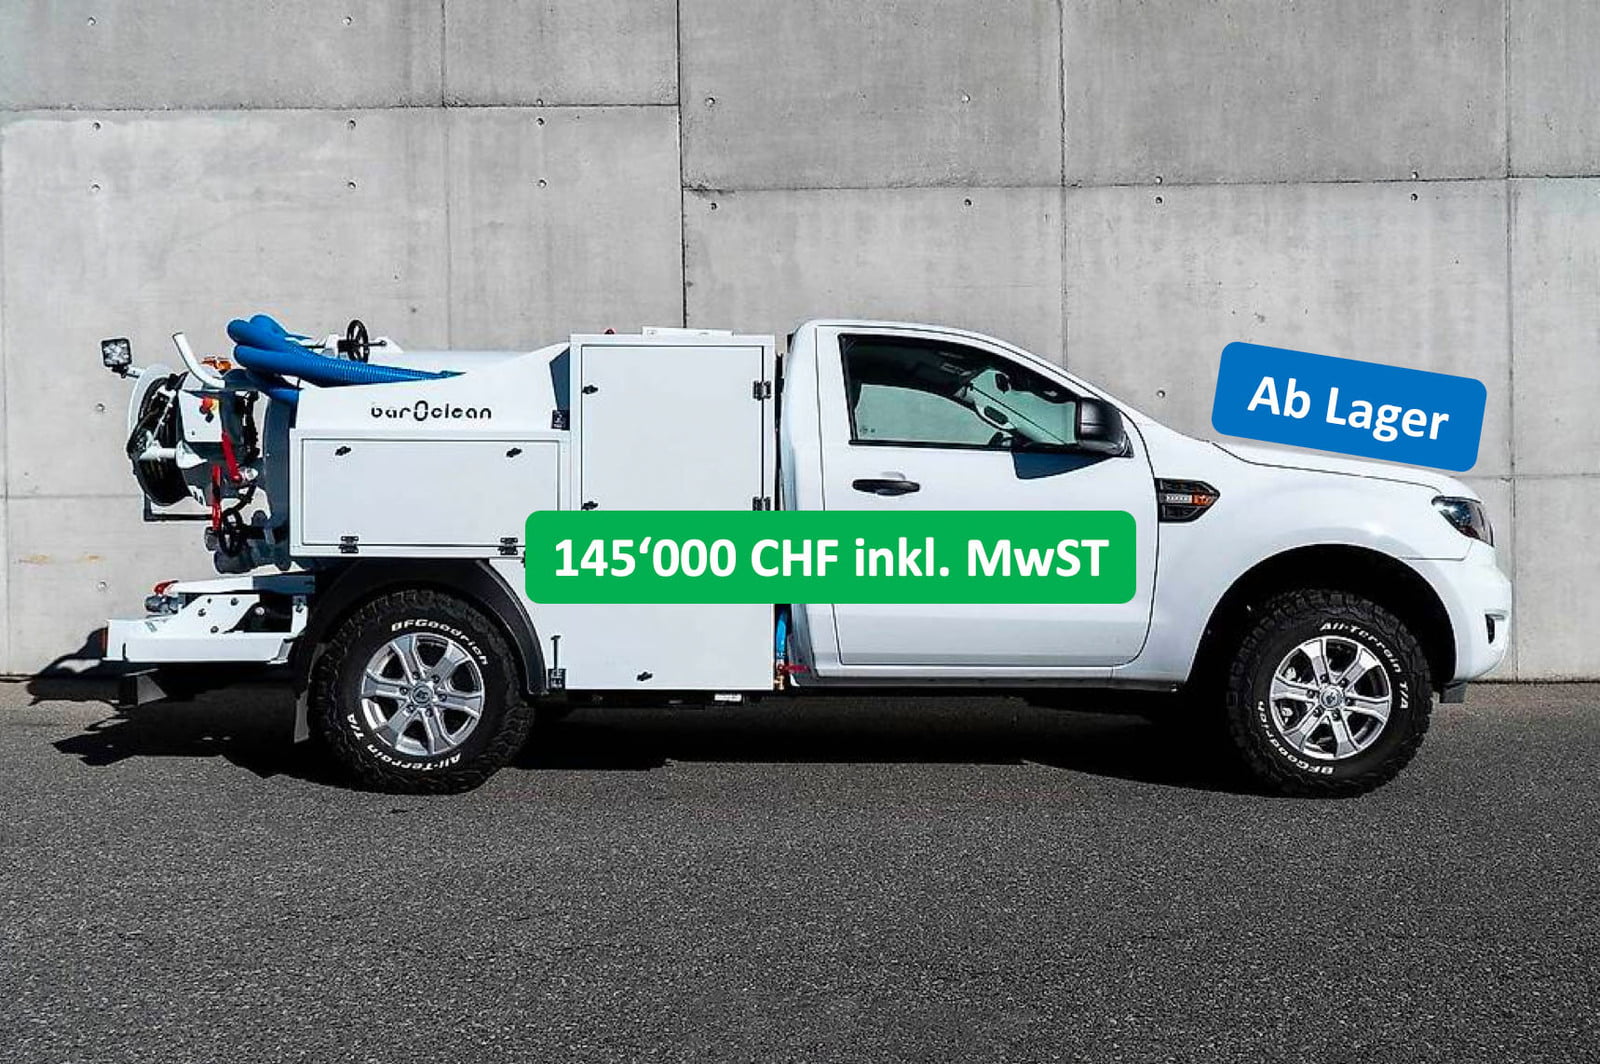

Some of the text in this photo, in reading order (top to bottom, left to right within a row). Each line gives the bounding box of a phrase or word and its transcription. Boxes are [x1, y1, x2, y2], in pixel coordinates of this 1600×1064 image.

[1320, 622, 1409, 709] All-Terrain T/A
[367, 744, 462, 771] All-Terrain
